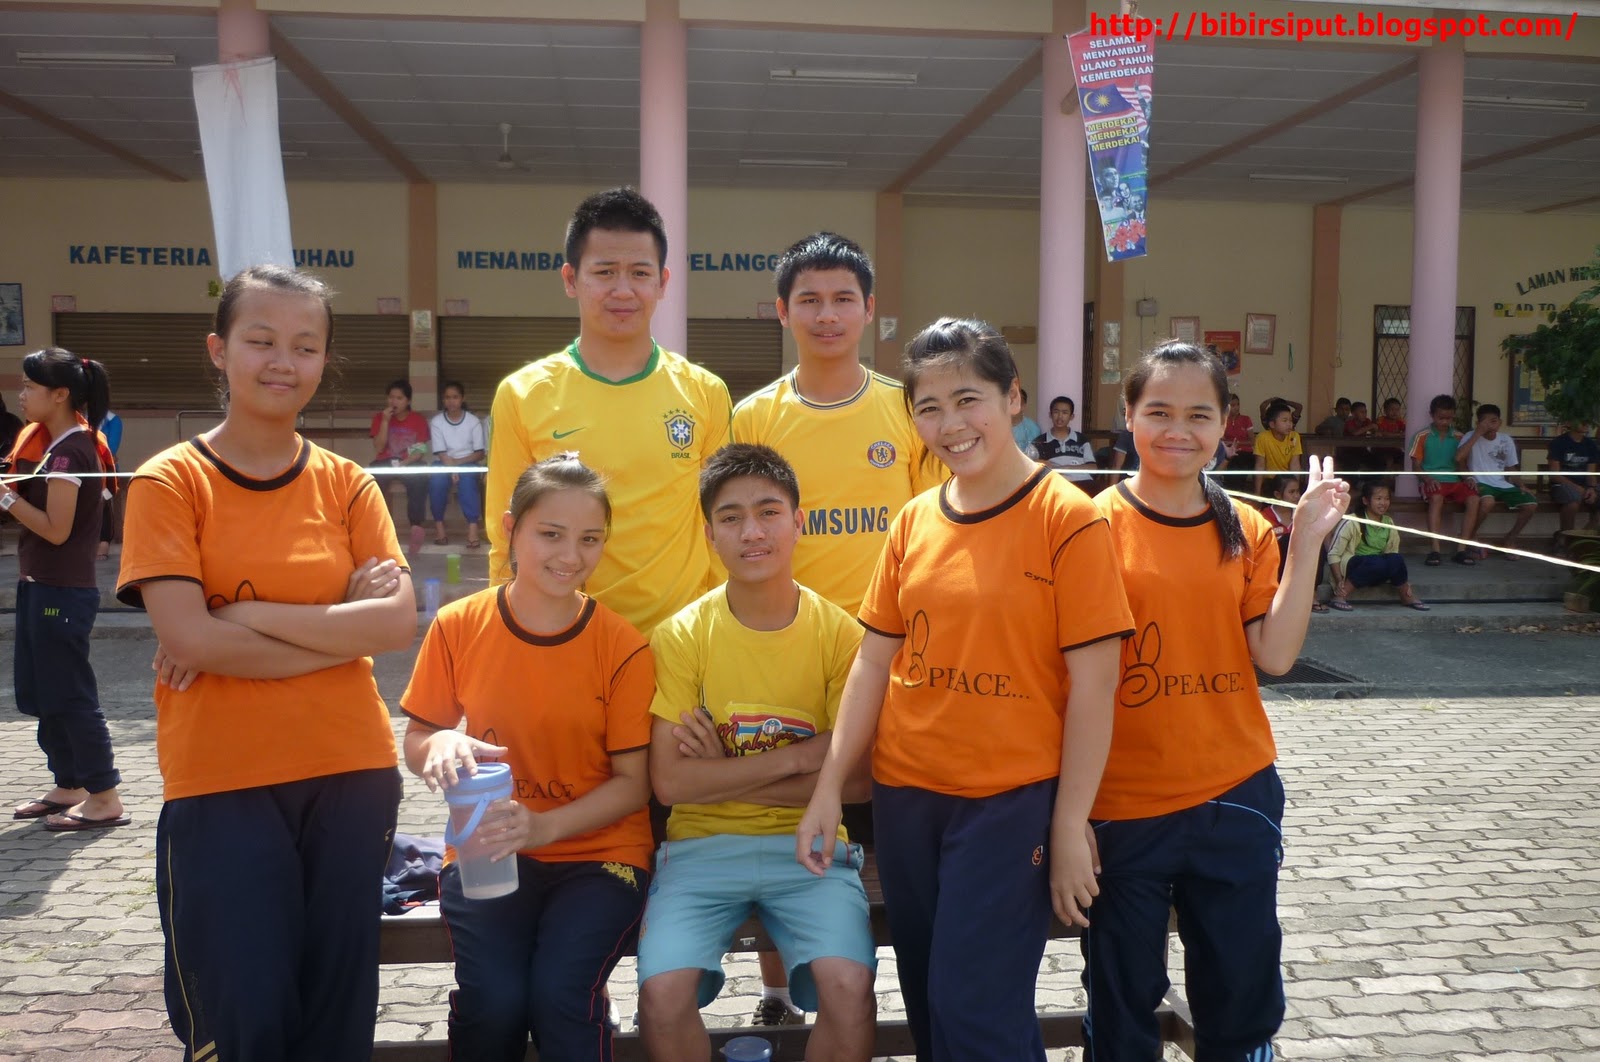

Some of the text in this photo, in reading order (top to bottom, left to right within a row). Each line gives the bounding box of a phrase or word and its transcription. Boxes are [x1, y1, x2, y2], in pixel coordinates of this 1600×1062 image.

[1089, 35, 1136, 49] SELAMAT
[1082, 44, 1147, 61] MENYAMBUT
[1080, 54, 1154, 72] ULANG TAHUN
[1080, 65, 1154, 84] KEMERDEKAA
[1088, 116, 1137, 132] MERDEKA!
[1090, 125, 1138, 142] MERDEKA!
[1091, 135, 1140, 152] MERDEKA!
[69, 245, 354, 268] KAFETERIA UHAU
[687, 253, 779, 272] ELANGG
[1516, 269, 1566, 296] LAMAN
[514, 778, 576, 801] EACE
